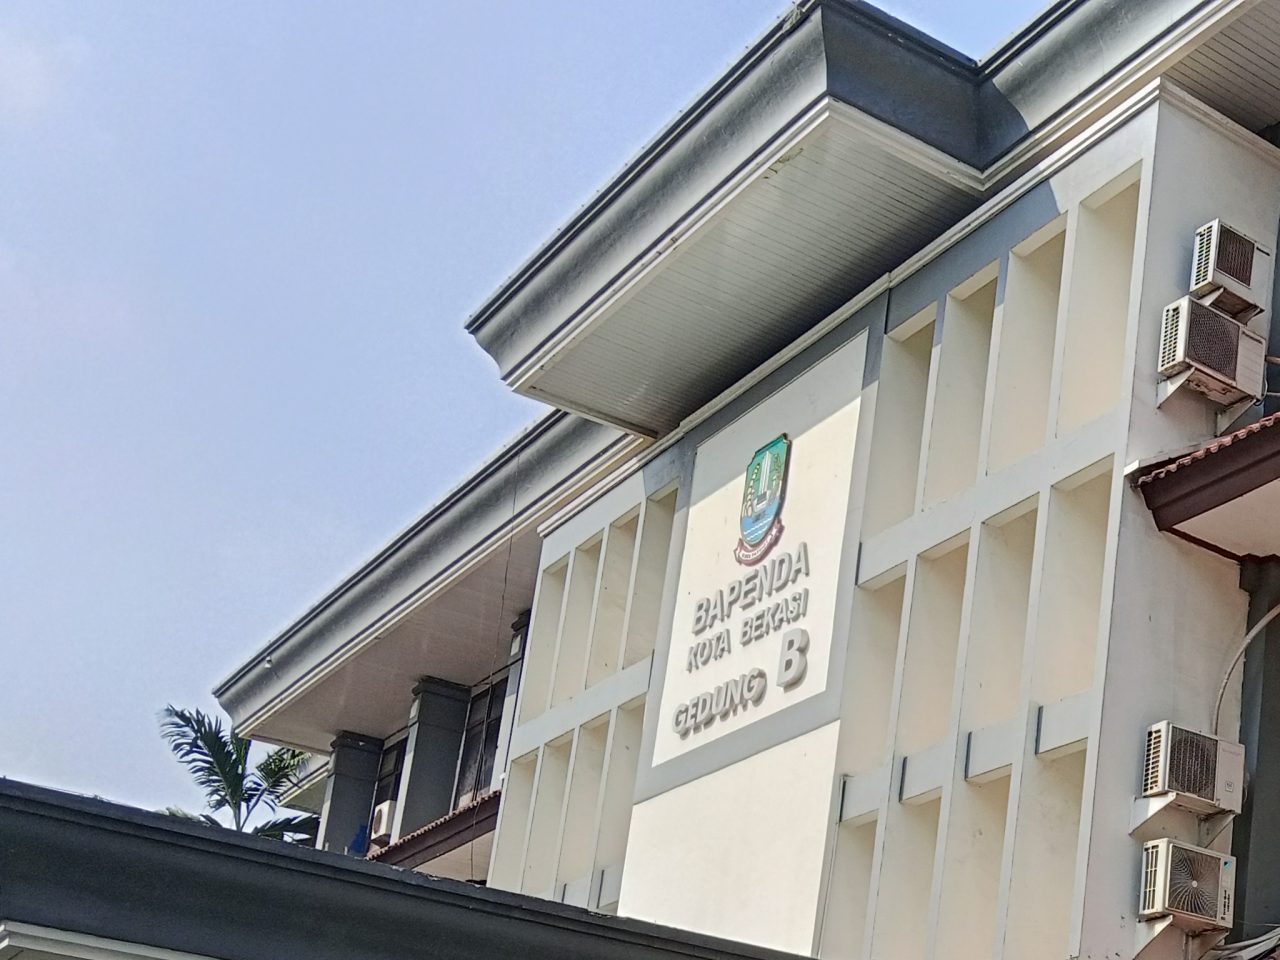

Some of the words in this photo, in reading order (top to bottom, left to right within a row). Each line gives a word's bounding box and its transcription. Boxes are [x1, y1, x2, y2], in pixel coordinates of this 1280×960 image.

[686, 628, 731, 673] KOTA
[740, 588, 809, 646] BEKASI
[692, 542, 810, 635] BAPENDA
[672, 668, 767, 740] GEDUNG
[776, 628, 810, 693] B
